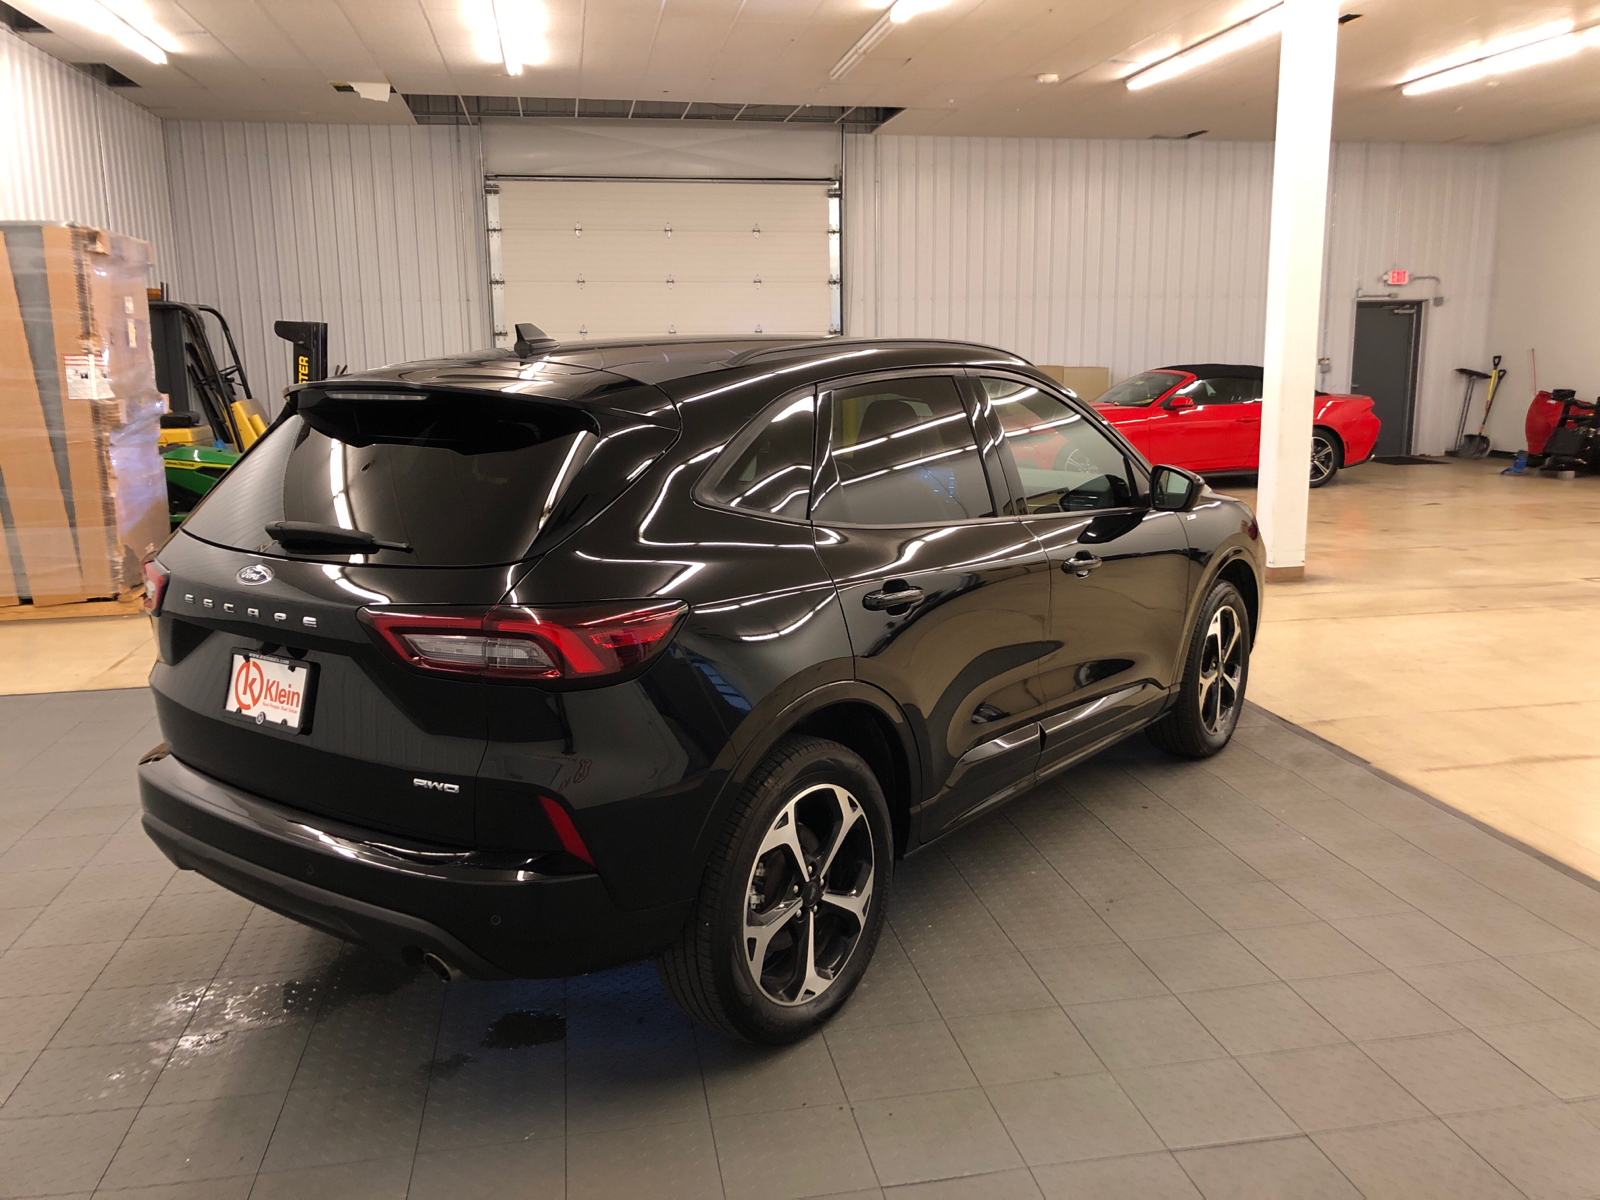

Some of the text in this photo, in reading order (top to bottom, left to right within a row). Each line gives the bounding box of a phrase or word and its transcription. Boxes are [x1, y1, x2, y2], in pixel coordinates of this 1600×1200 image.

[1391, 270, 1407, 284] EXIT
[239, 566, 269, 582] Ford
[184, 593, 317, 628] ESCAPE
[263, 678, 301, 708] Klein
[413, 777, 460, 794] AWD
